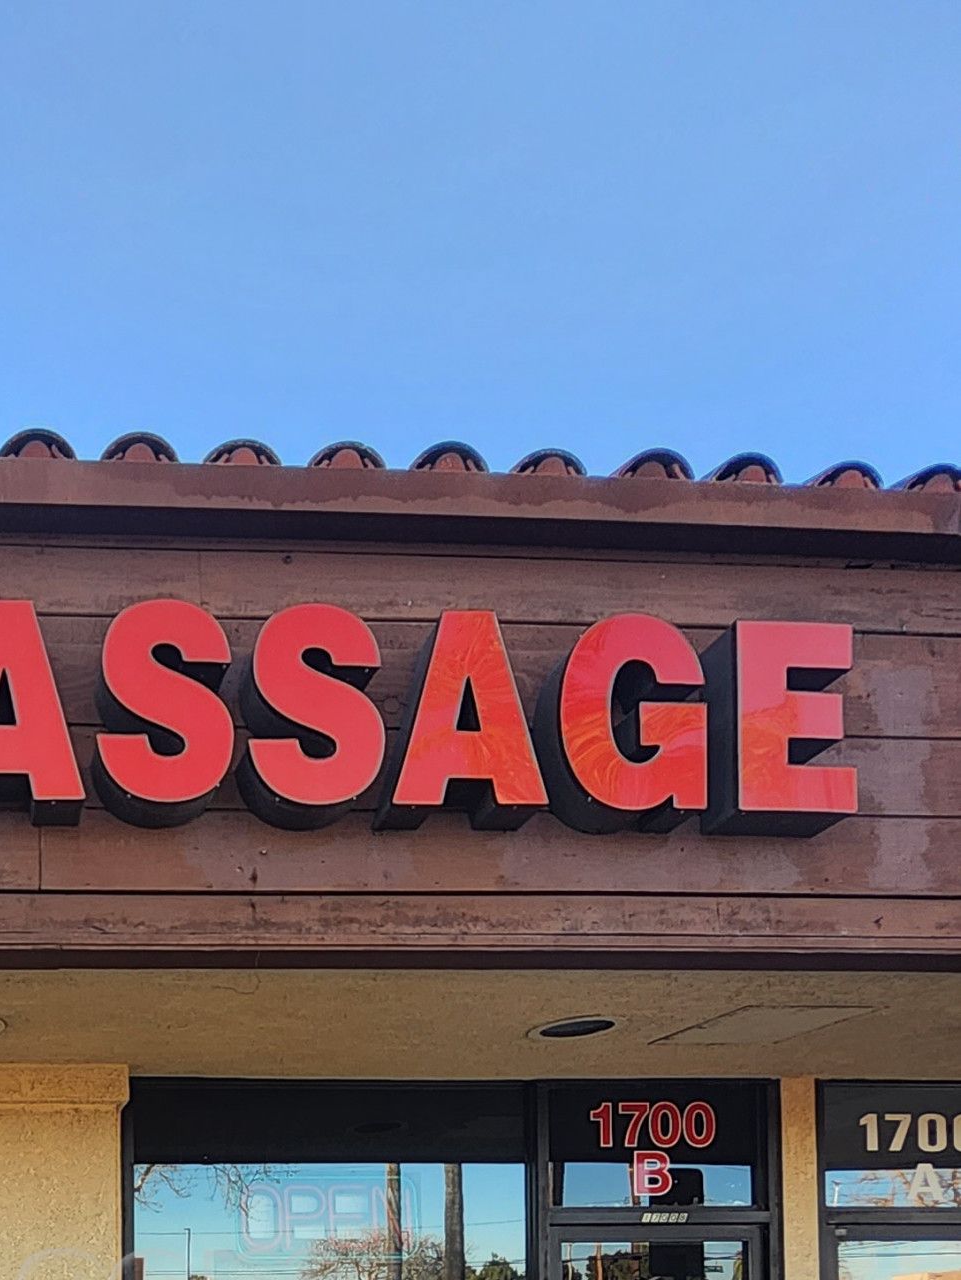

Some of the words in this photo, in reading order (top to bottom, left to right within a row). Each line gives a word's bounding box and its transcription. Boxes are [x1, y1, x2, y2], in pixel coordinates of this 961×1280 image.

[590, 1101, 716, 1148] 1700
[859, 1113, 961, 1152] 170
[633, 1150, 673, 1196] B
[906, 1163, 944, 1201] A
[240, 1183, 412, 1251] OPEN
